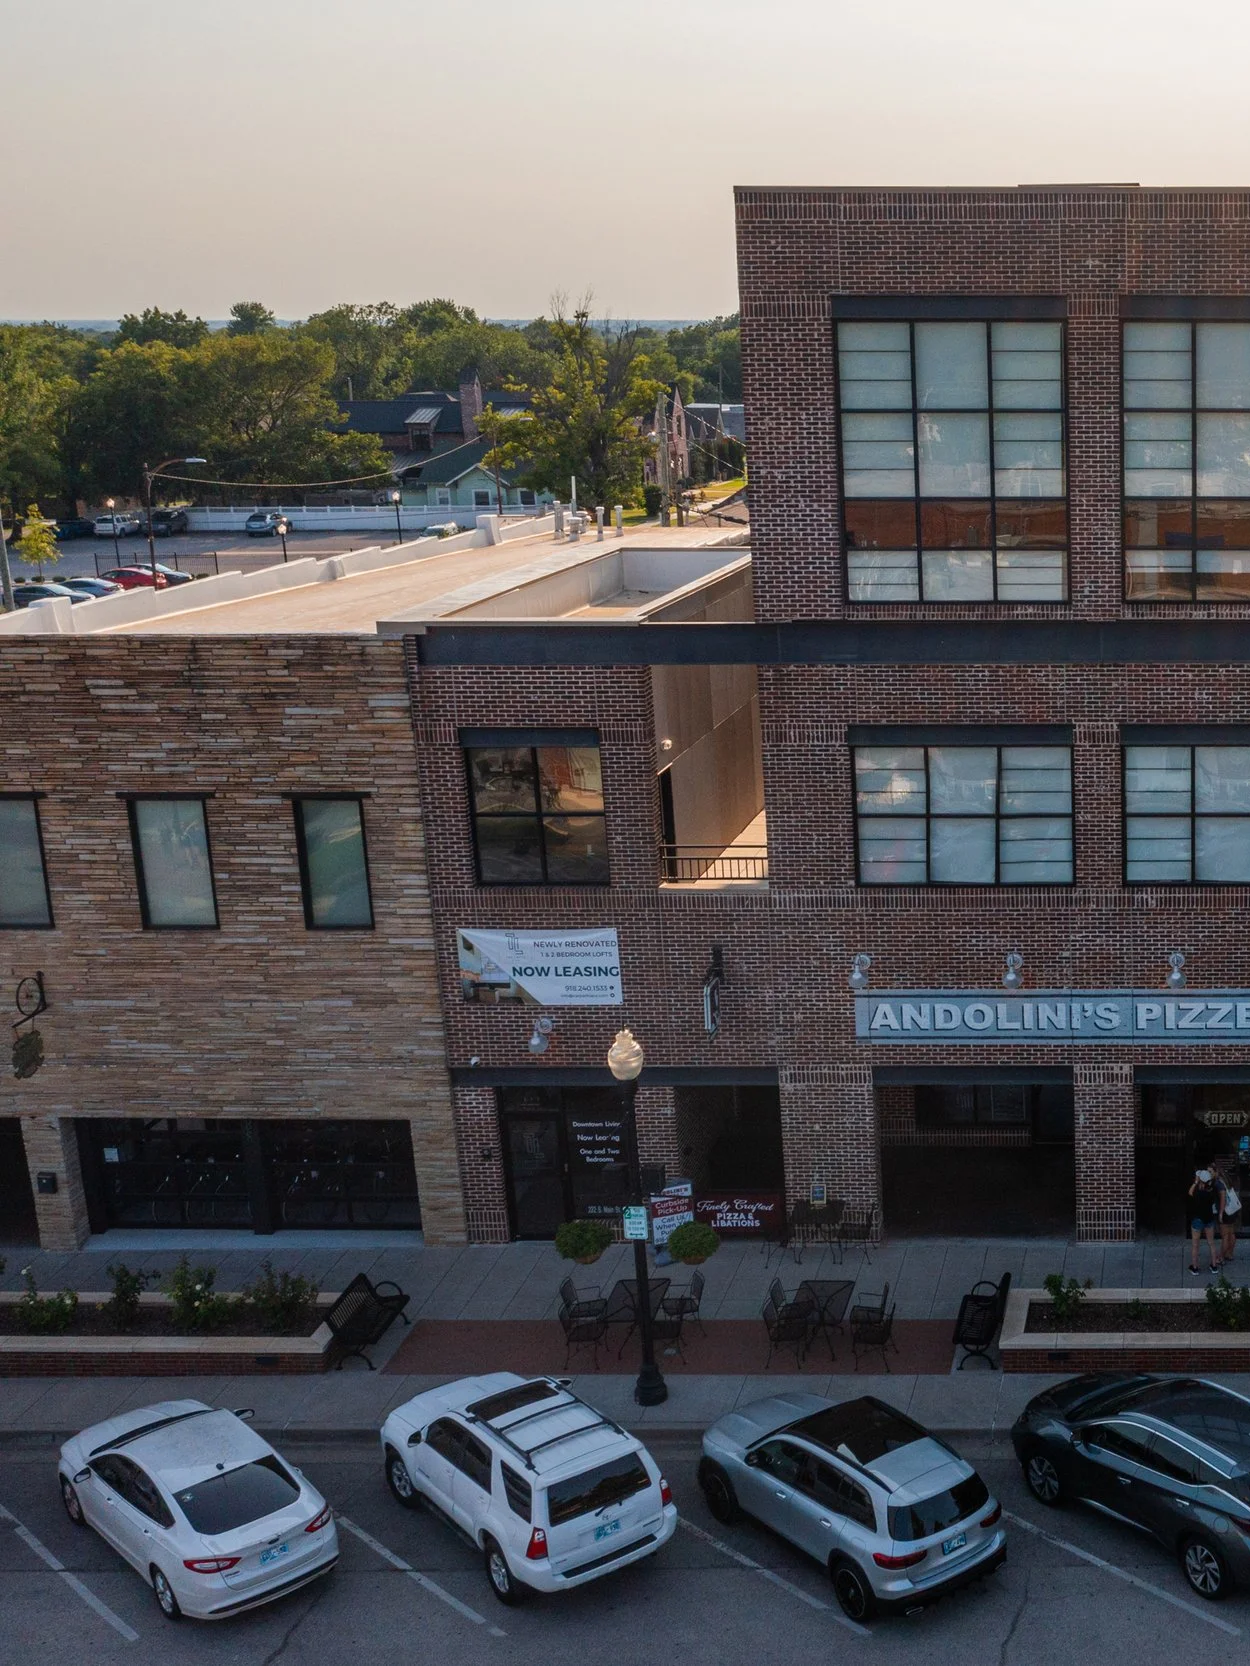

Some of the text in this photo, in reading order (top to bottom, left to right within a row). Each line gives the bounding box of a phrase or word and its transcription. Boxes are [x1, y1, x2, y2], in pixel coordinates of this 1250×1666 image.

[533, 940, 617, 948] NEWLY RENOVATED
[512, 966, 620, 977] NOW LEASING
[869, 1001, 1121, 1030] ANDOLINI'S
[1211, 1113, 1241, 1124] OPEN
[655, 1198, 689, 1209] Curbside
[696, 1199, 775, 1212] Finely Crafted
[657, 1205, 688, 1215] Pick-Up
[716, 1212, 744, 1220] PIZZA
[711, 1219, 760, 1227] LIBATIONS
